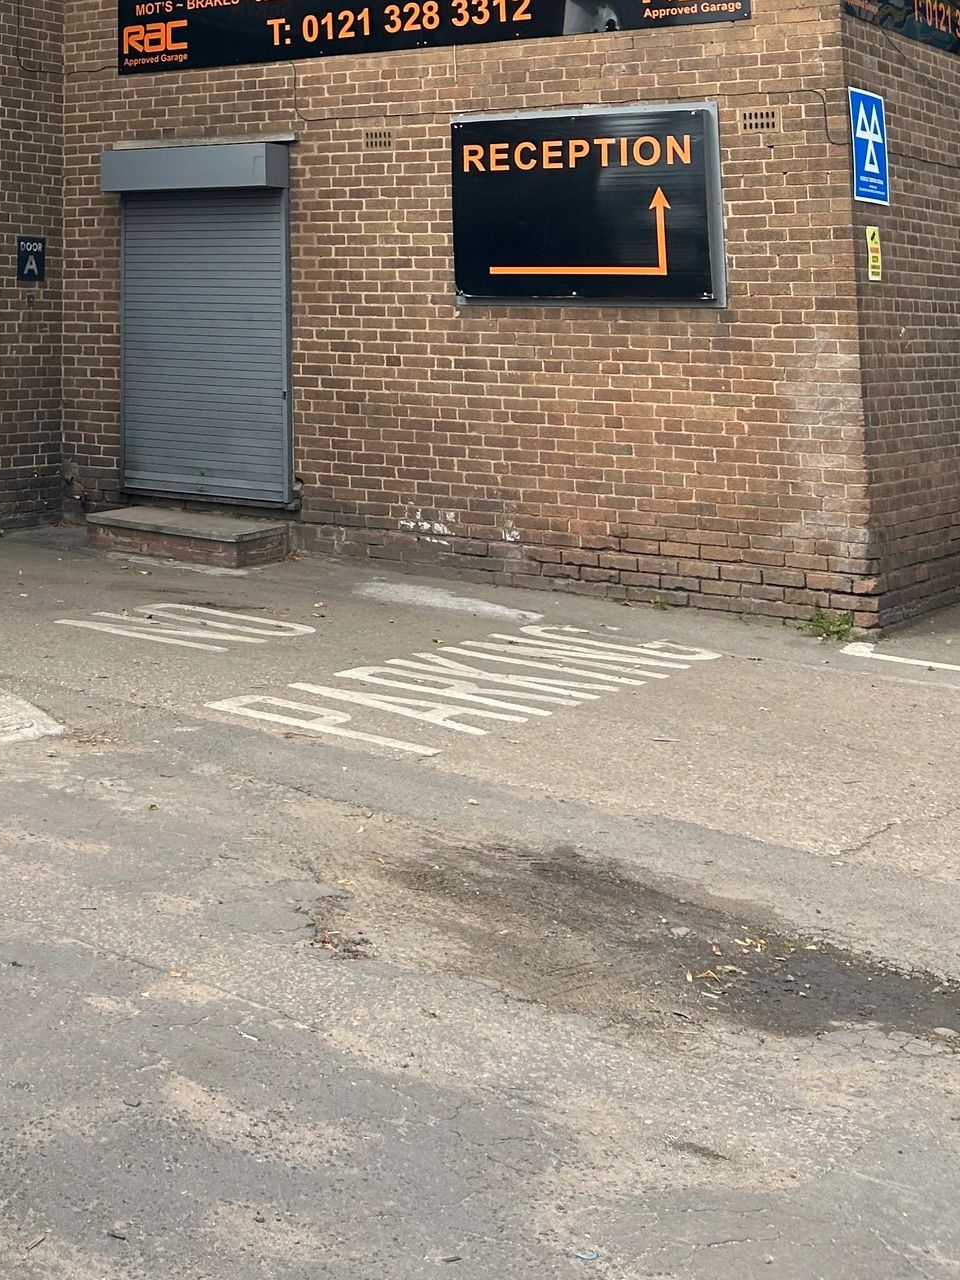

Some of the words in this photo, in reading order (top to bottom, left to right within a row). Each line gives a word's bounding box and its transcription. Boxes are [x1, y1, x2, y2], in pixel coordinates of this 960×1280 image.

[136, 0, 173, 16] MOT'S
[643, 4, 698, 19] Approved
[701, 1, 742, 14] Garage
[267, 18, 291, 46] T:
[302, 7, 371, 43] 0121
[384, 0, 440, 33] 328
[124, 54, 159, 67] Approved
[160, 52, 188, 63] Garage
[463, 134, 691, 172] RECEPTION
[20, 241, 43, 252] DOOR
[23, 255, 39, 275] A
[53, 603, 317, 653] NO
[205, 623, 722, 755] PARKING
